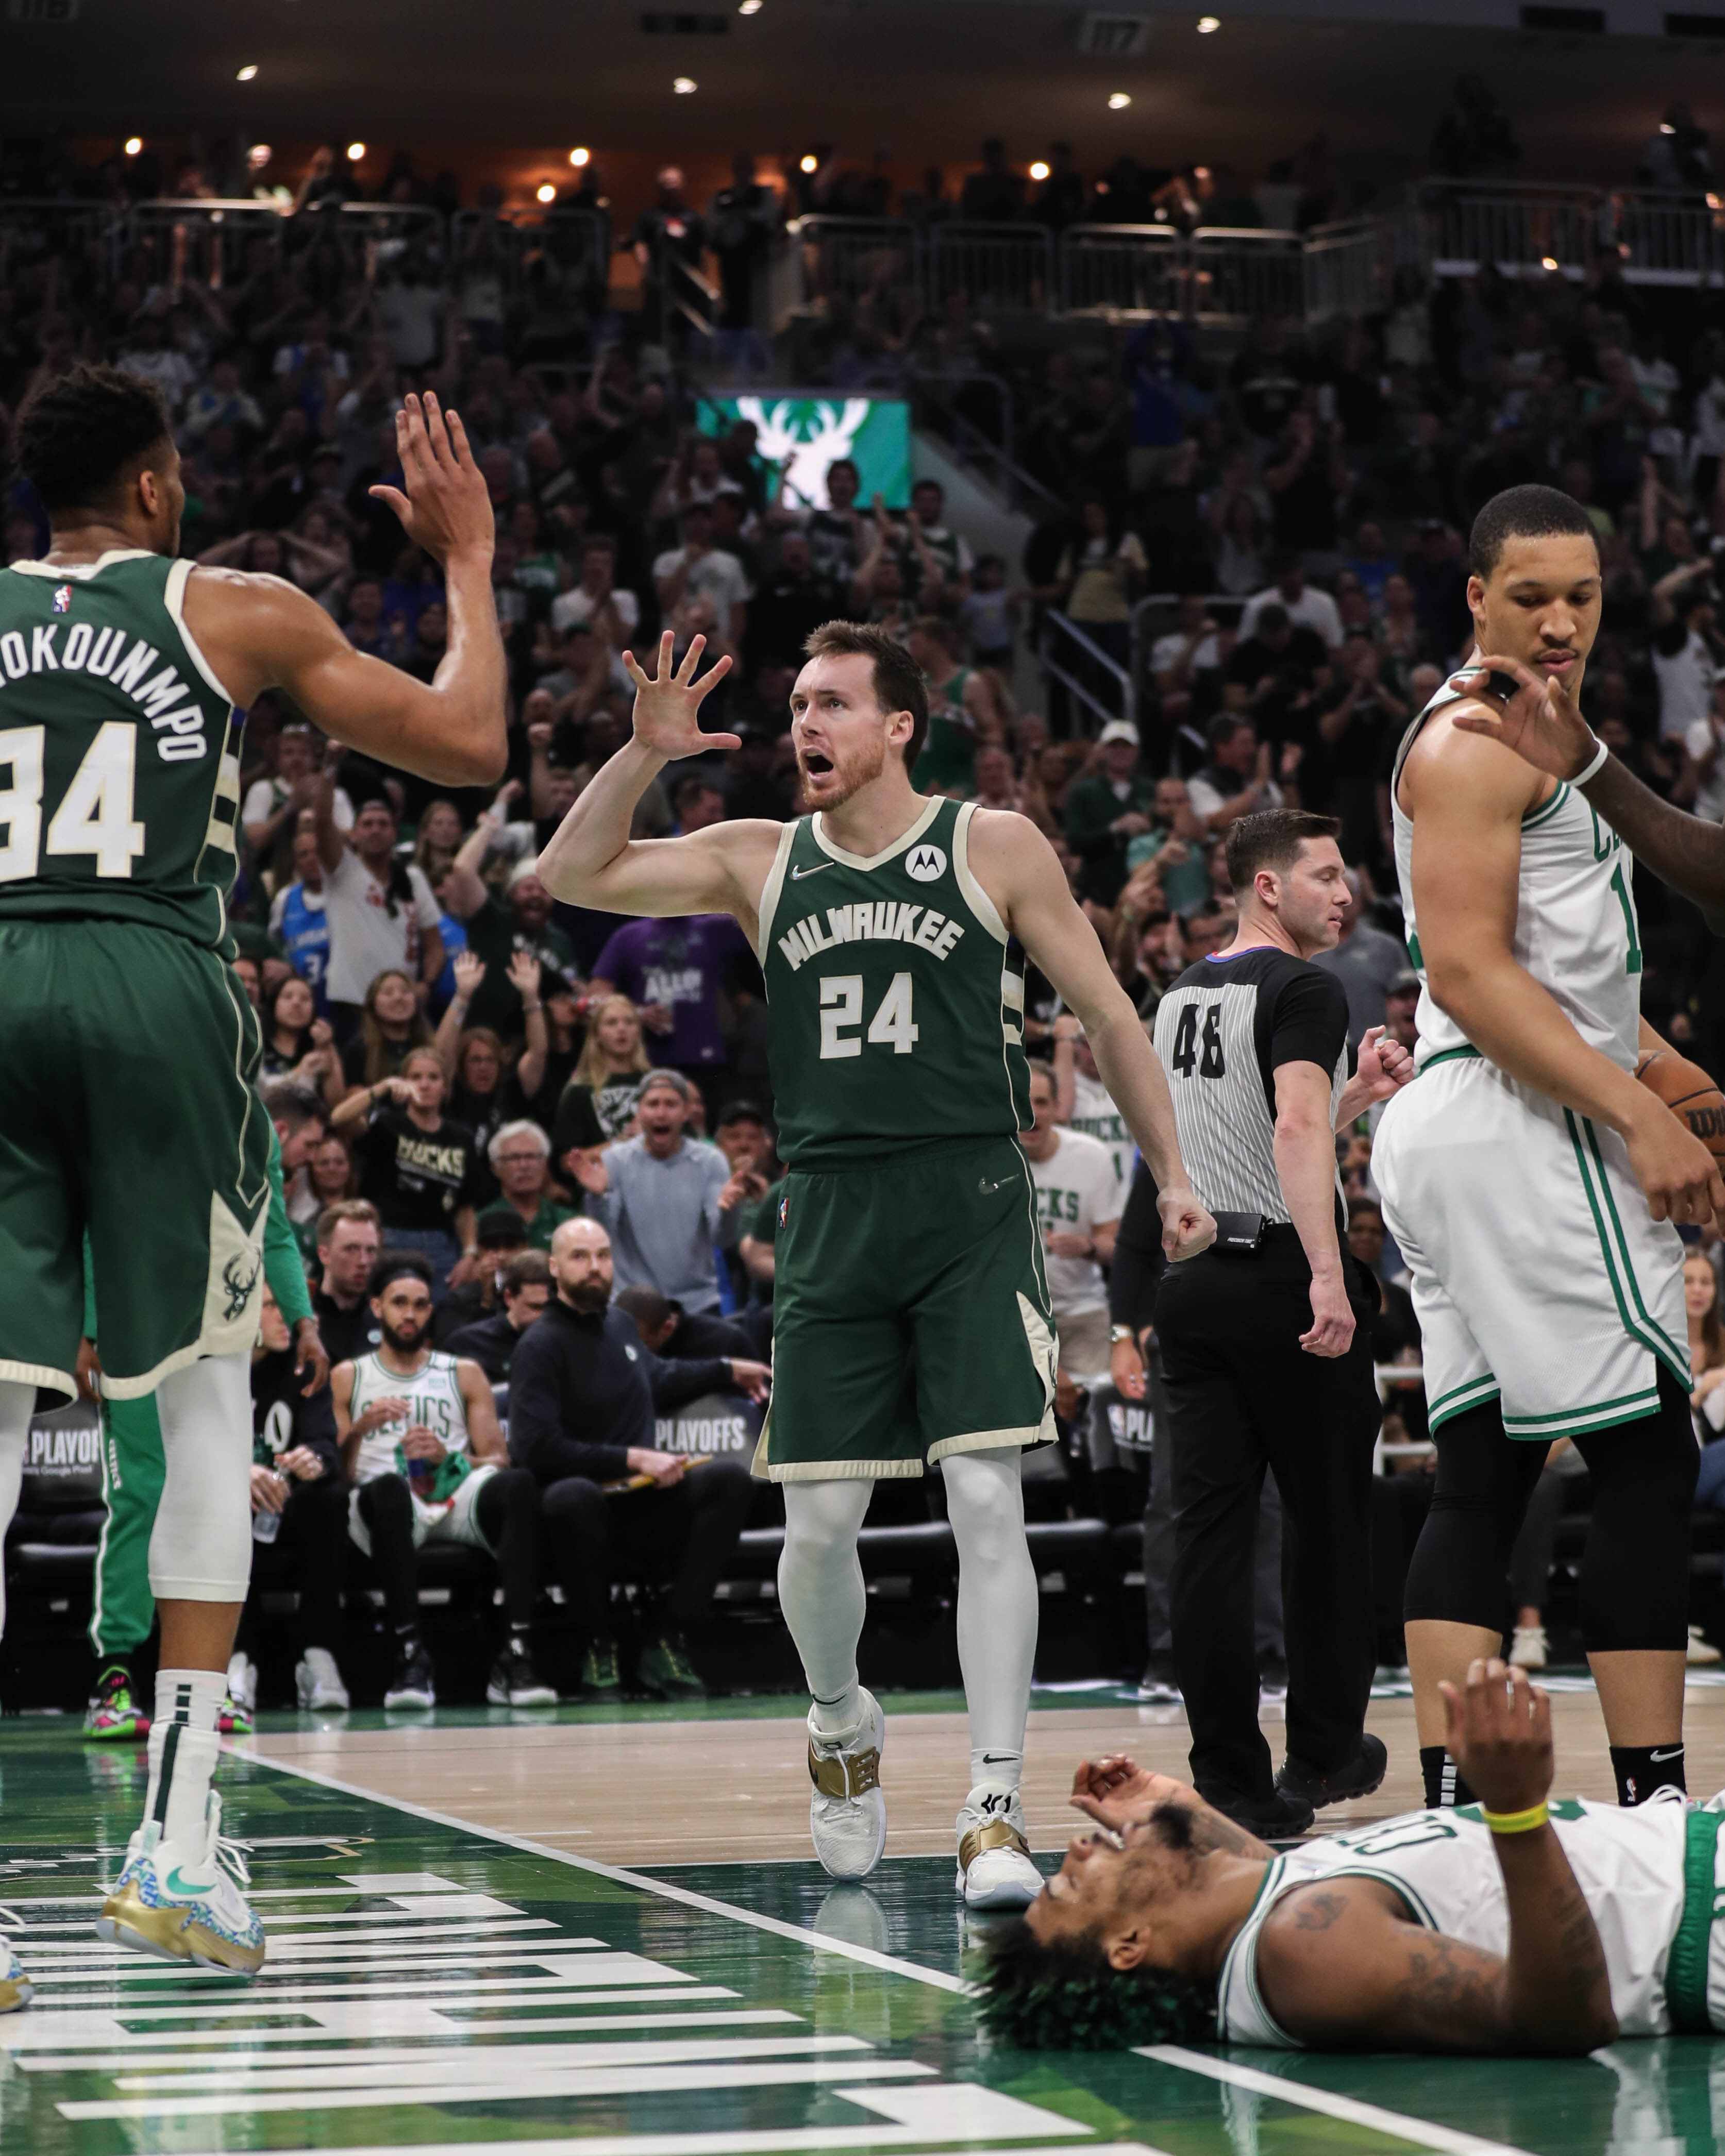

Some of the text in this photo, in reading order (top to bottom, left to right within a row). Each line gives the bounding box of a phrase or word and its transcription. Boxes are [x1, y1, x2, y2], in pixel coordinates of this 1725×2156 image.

[0, 622, 207, 761] OKOUNMPO
[778, 902, 965, 971] MILWAUKEE
[819, 972, 918, 1059] 24
[1173, 1002, 1225, 1079] 46
[396, 1134, 465, 1178] BUCKS
[655, 1416, 746, 1453] PLAYOFFS
